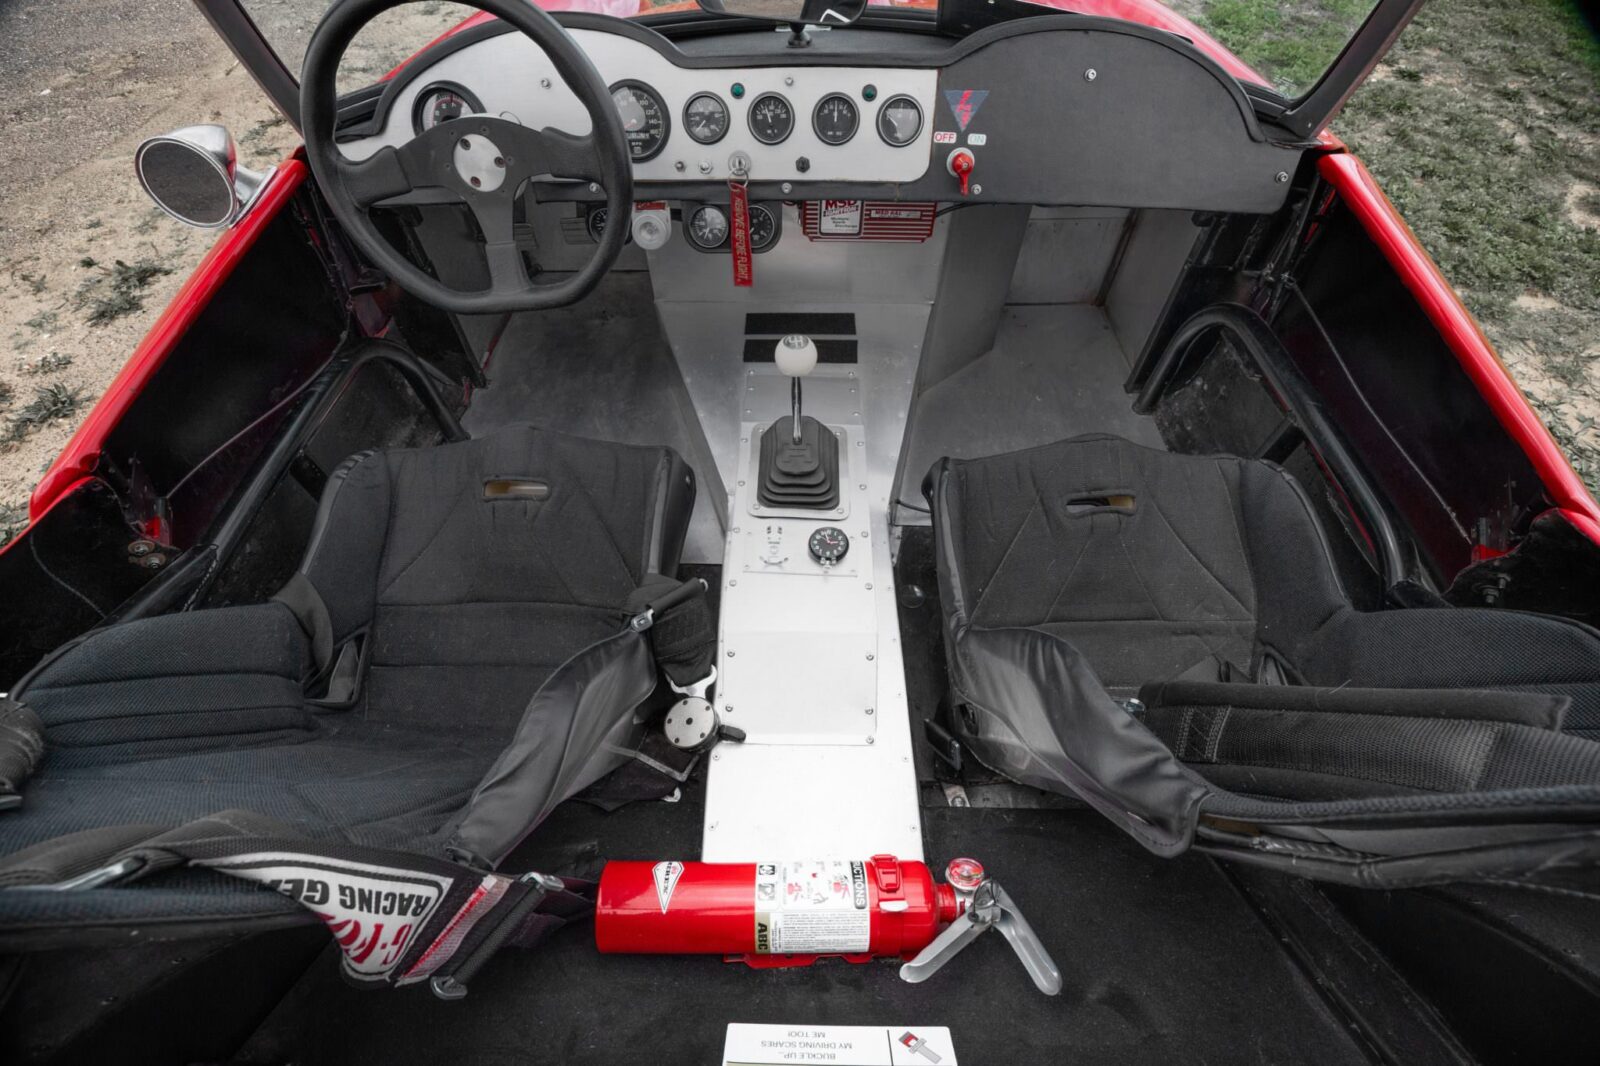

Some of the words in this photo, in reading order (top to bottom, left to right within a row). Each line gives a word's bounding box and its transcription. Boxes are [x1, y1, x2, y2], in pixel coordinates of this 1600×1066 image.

[934, 133, 954, 142] OFF
[970, 134, 984, 143] ON
[825, 199, 857, 210] MSD
[734, 196, 745, 228] REMOVE
[735, 228, 747, 256] BEFORE
[338, 883, 432, 917] RACING
[758, 922, 768, 951] ABC
[812, 1031, 826, 1039] ME
[761, 1040, 798, 1049] SCARES
[798, 1041, 836, 1049] DRIVING
[838, 1042, 853, 1050] MY
[798, 1052, 836, 1060] BUCKLE
